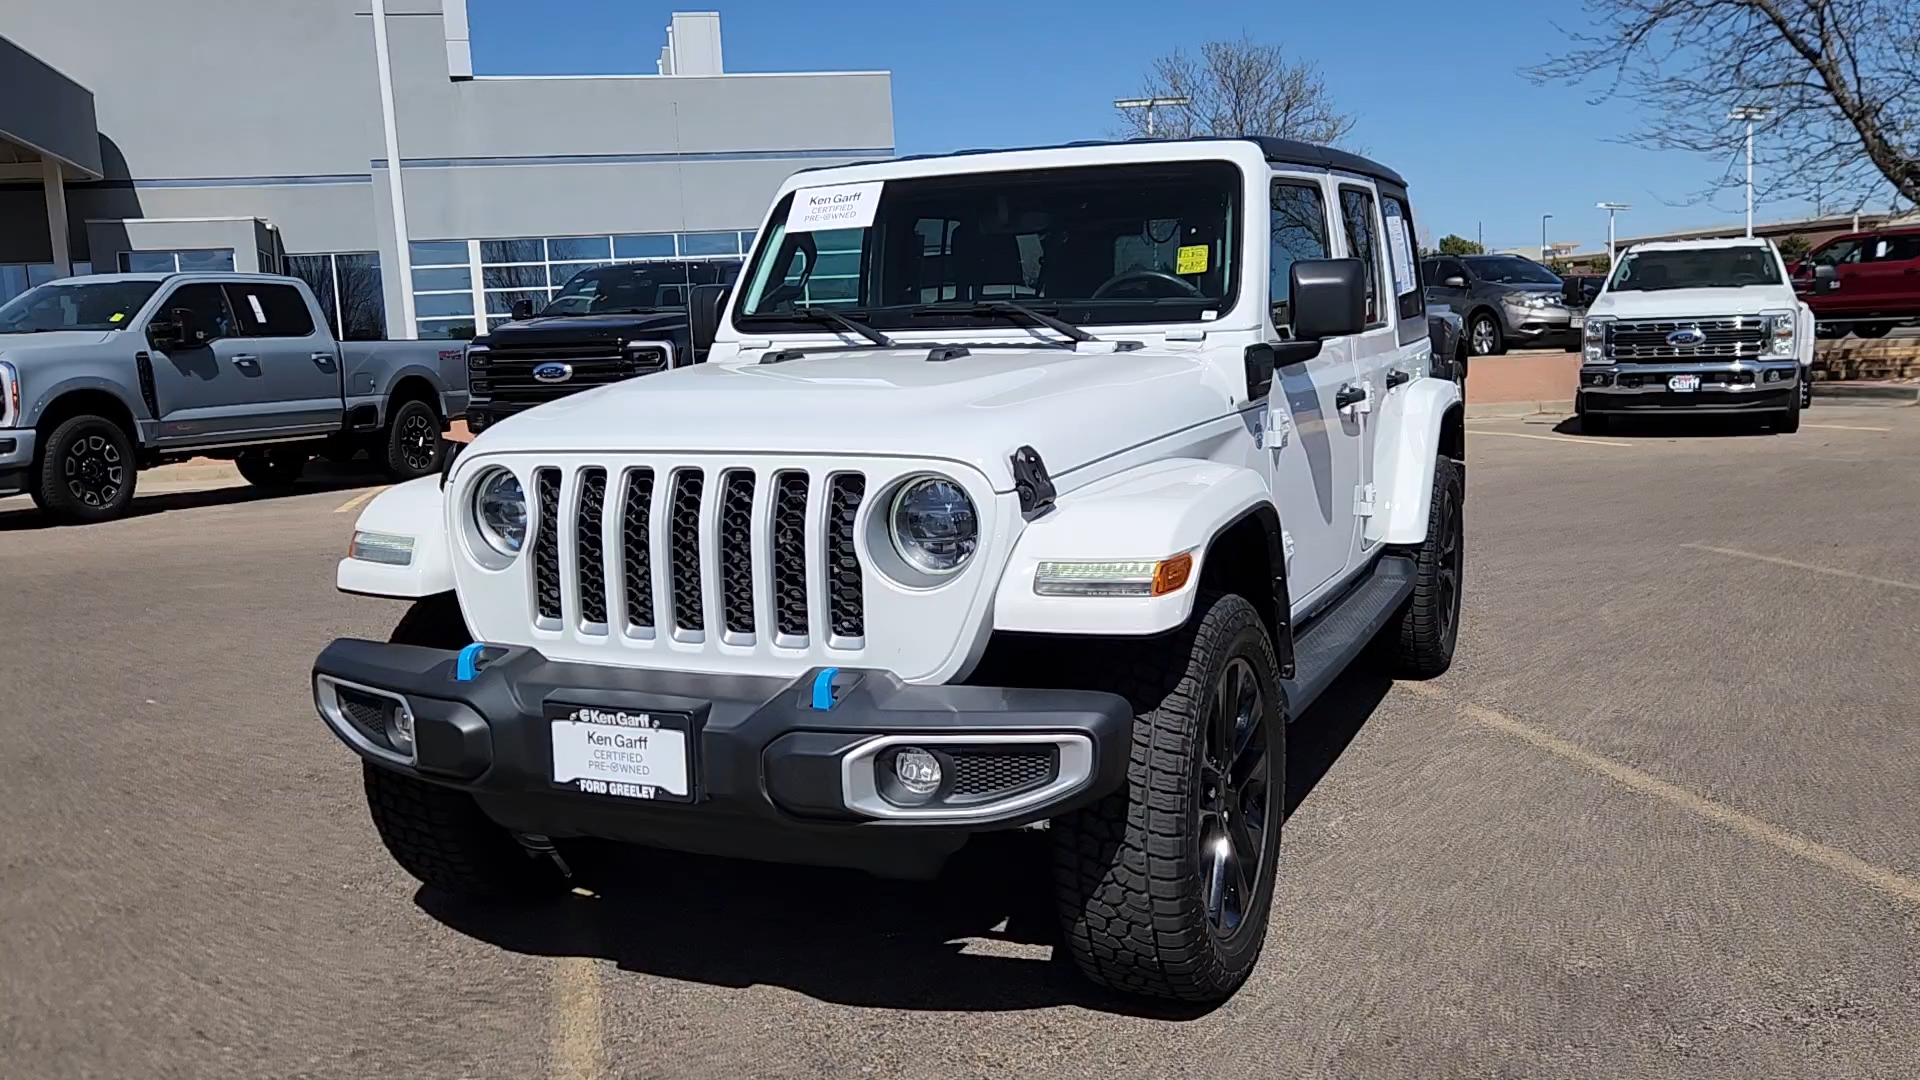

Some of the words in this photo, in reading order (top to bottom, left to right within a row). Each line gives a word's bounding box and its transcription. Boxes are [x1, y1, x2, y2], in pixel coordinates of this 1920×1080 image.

[809, 195, 832, 206] Ken
[833, 192, 862, 204] Garff
[811, 204, 854, 214] CERTIFIED
[590, 709, 616, 725] Ken
[615, 712, 650, 728] Garff
[587, 730, 612, 747] Ken
[614, 734, 648, 750] Garff
[593, 749, 643, 763] CERTIFIED
[579, 780, 607, 794] FORD
[608, 781, 656, 800] GREELEY
